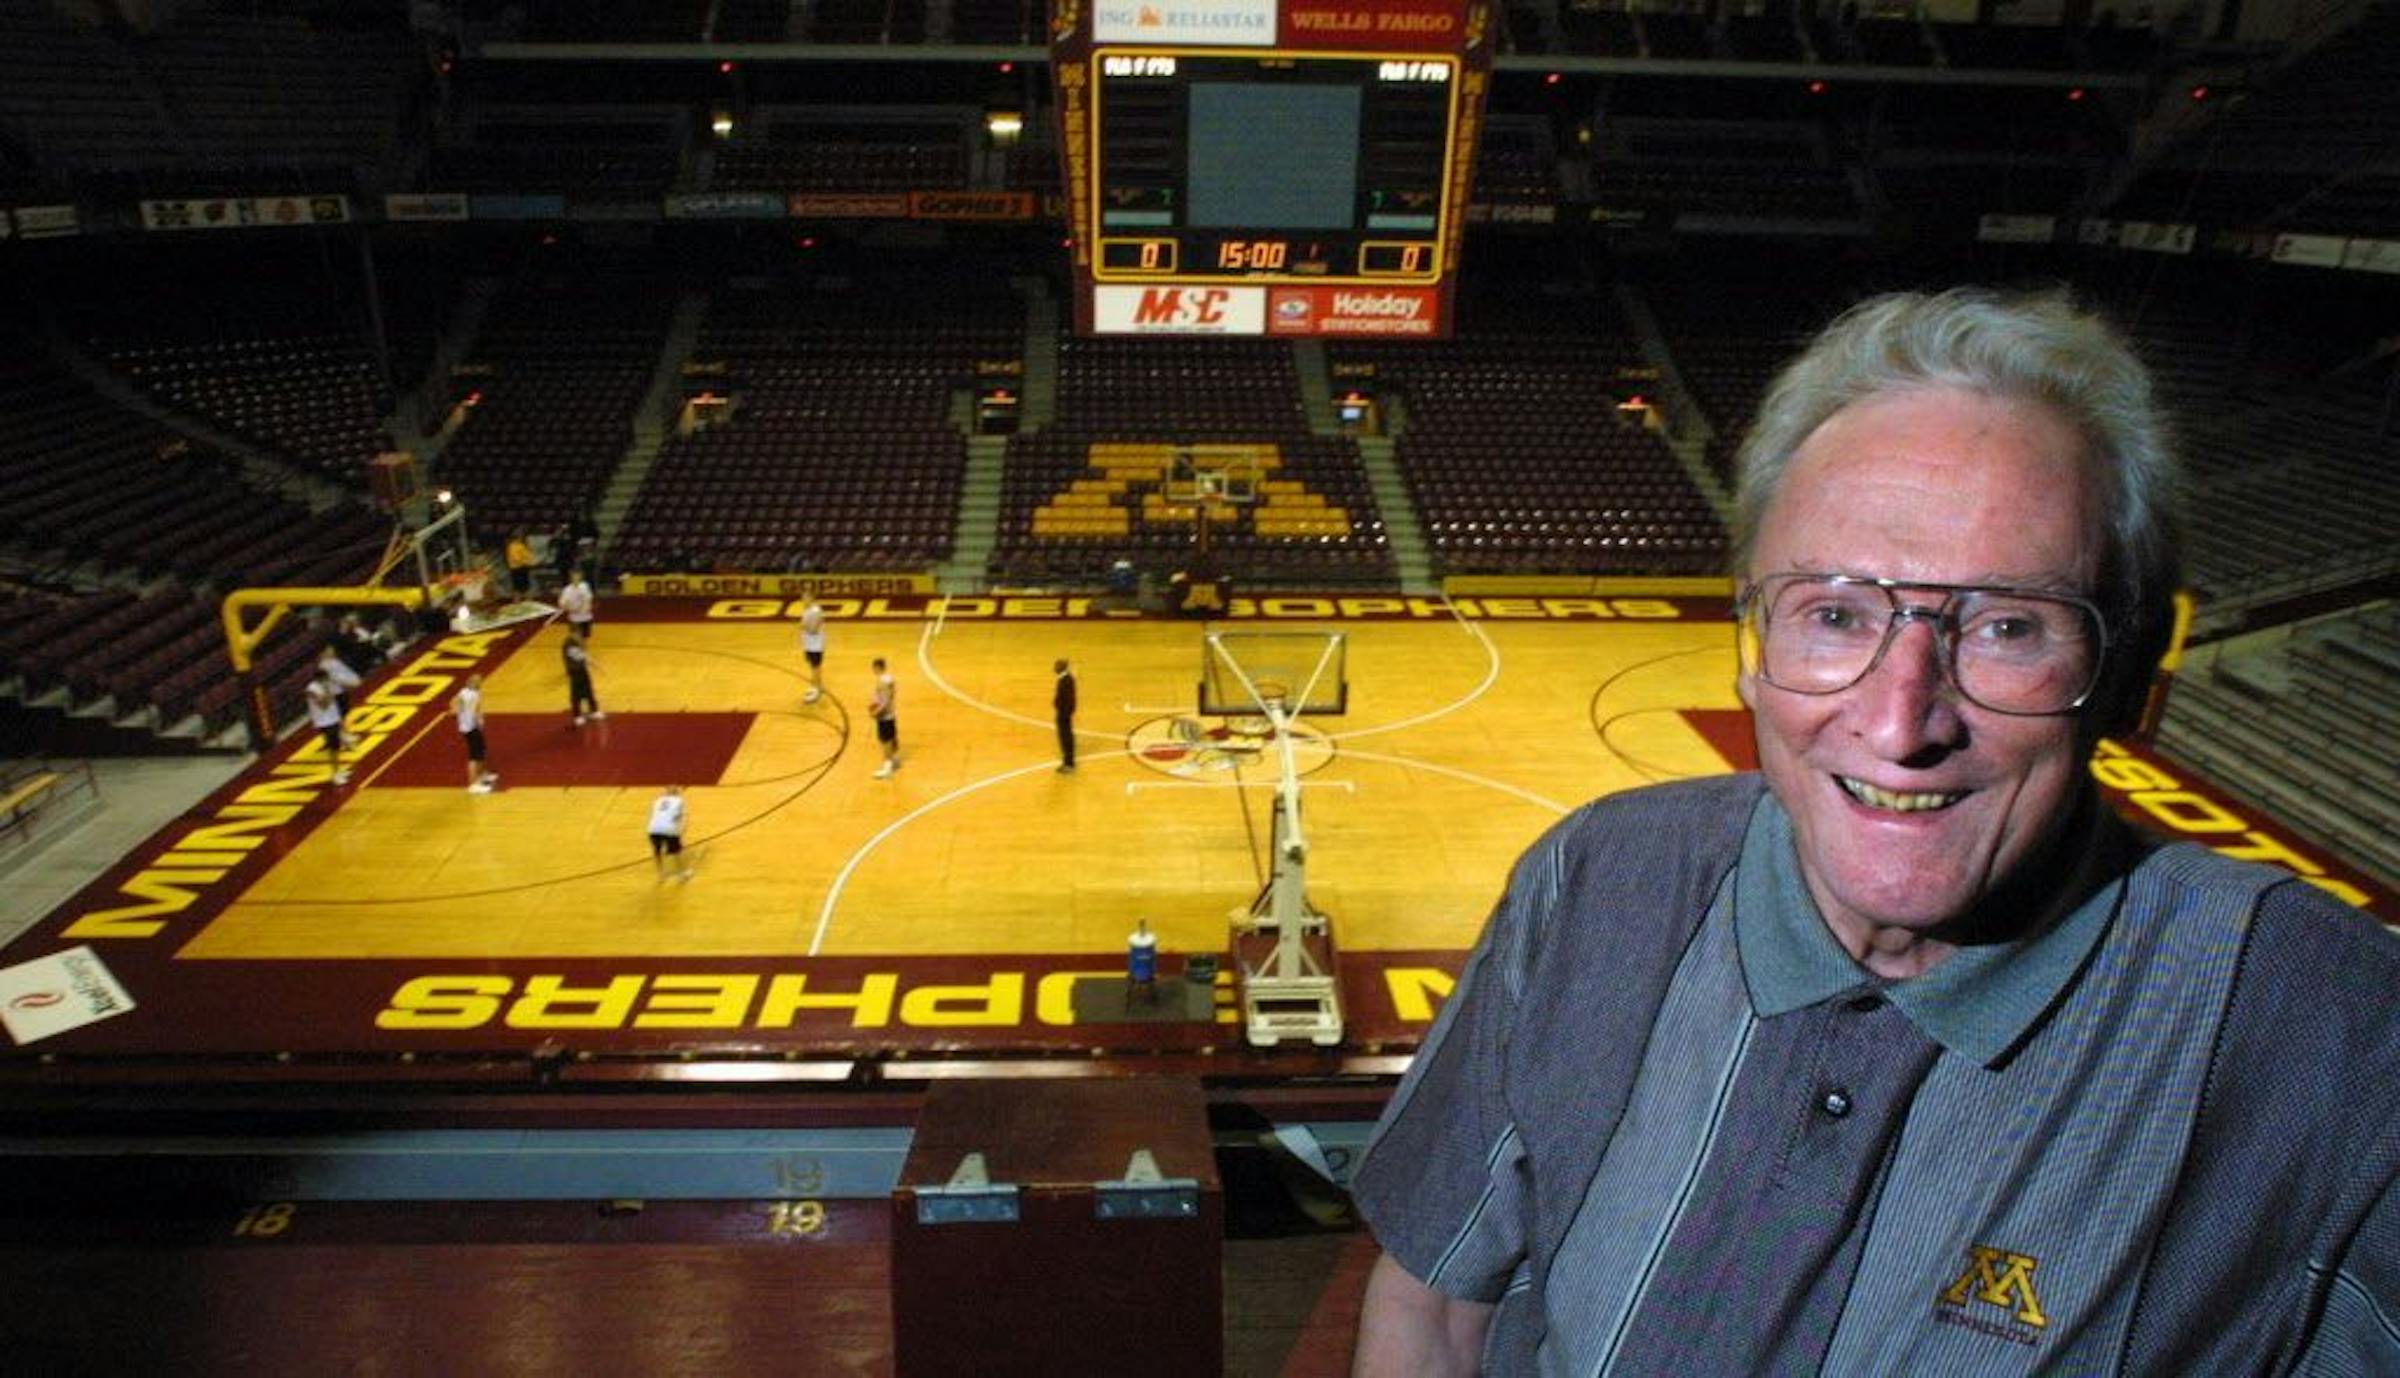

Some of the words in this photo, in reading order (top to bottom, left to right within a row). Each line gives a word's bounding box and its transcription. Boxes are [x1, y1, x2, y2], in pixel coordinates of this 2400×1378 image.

[1292, 13, 1370, 31] WELLS
[1377, 14, 1453, 32] FARGO
[1141, 242, 1159, 269] 0
[1218, 241, 1287, 269] 15:00
[1401, 244, 1420, 272] 0
[1133, 287, 1229, 325] MSC
[1332, 292, 1424, 320] Holiday
[645, 577, 760, 595] GOLDEN
[779, 577, 914, 595] GOPHERS
[59, 629, 513, 938] MINNESOTA
[231, 1203, 297, 1237] 18
[768, 1200, 825, 1233] 19
